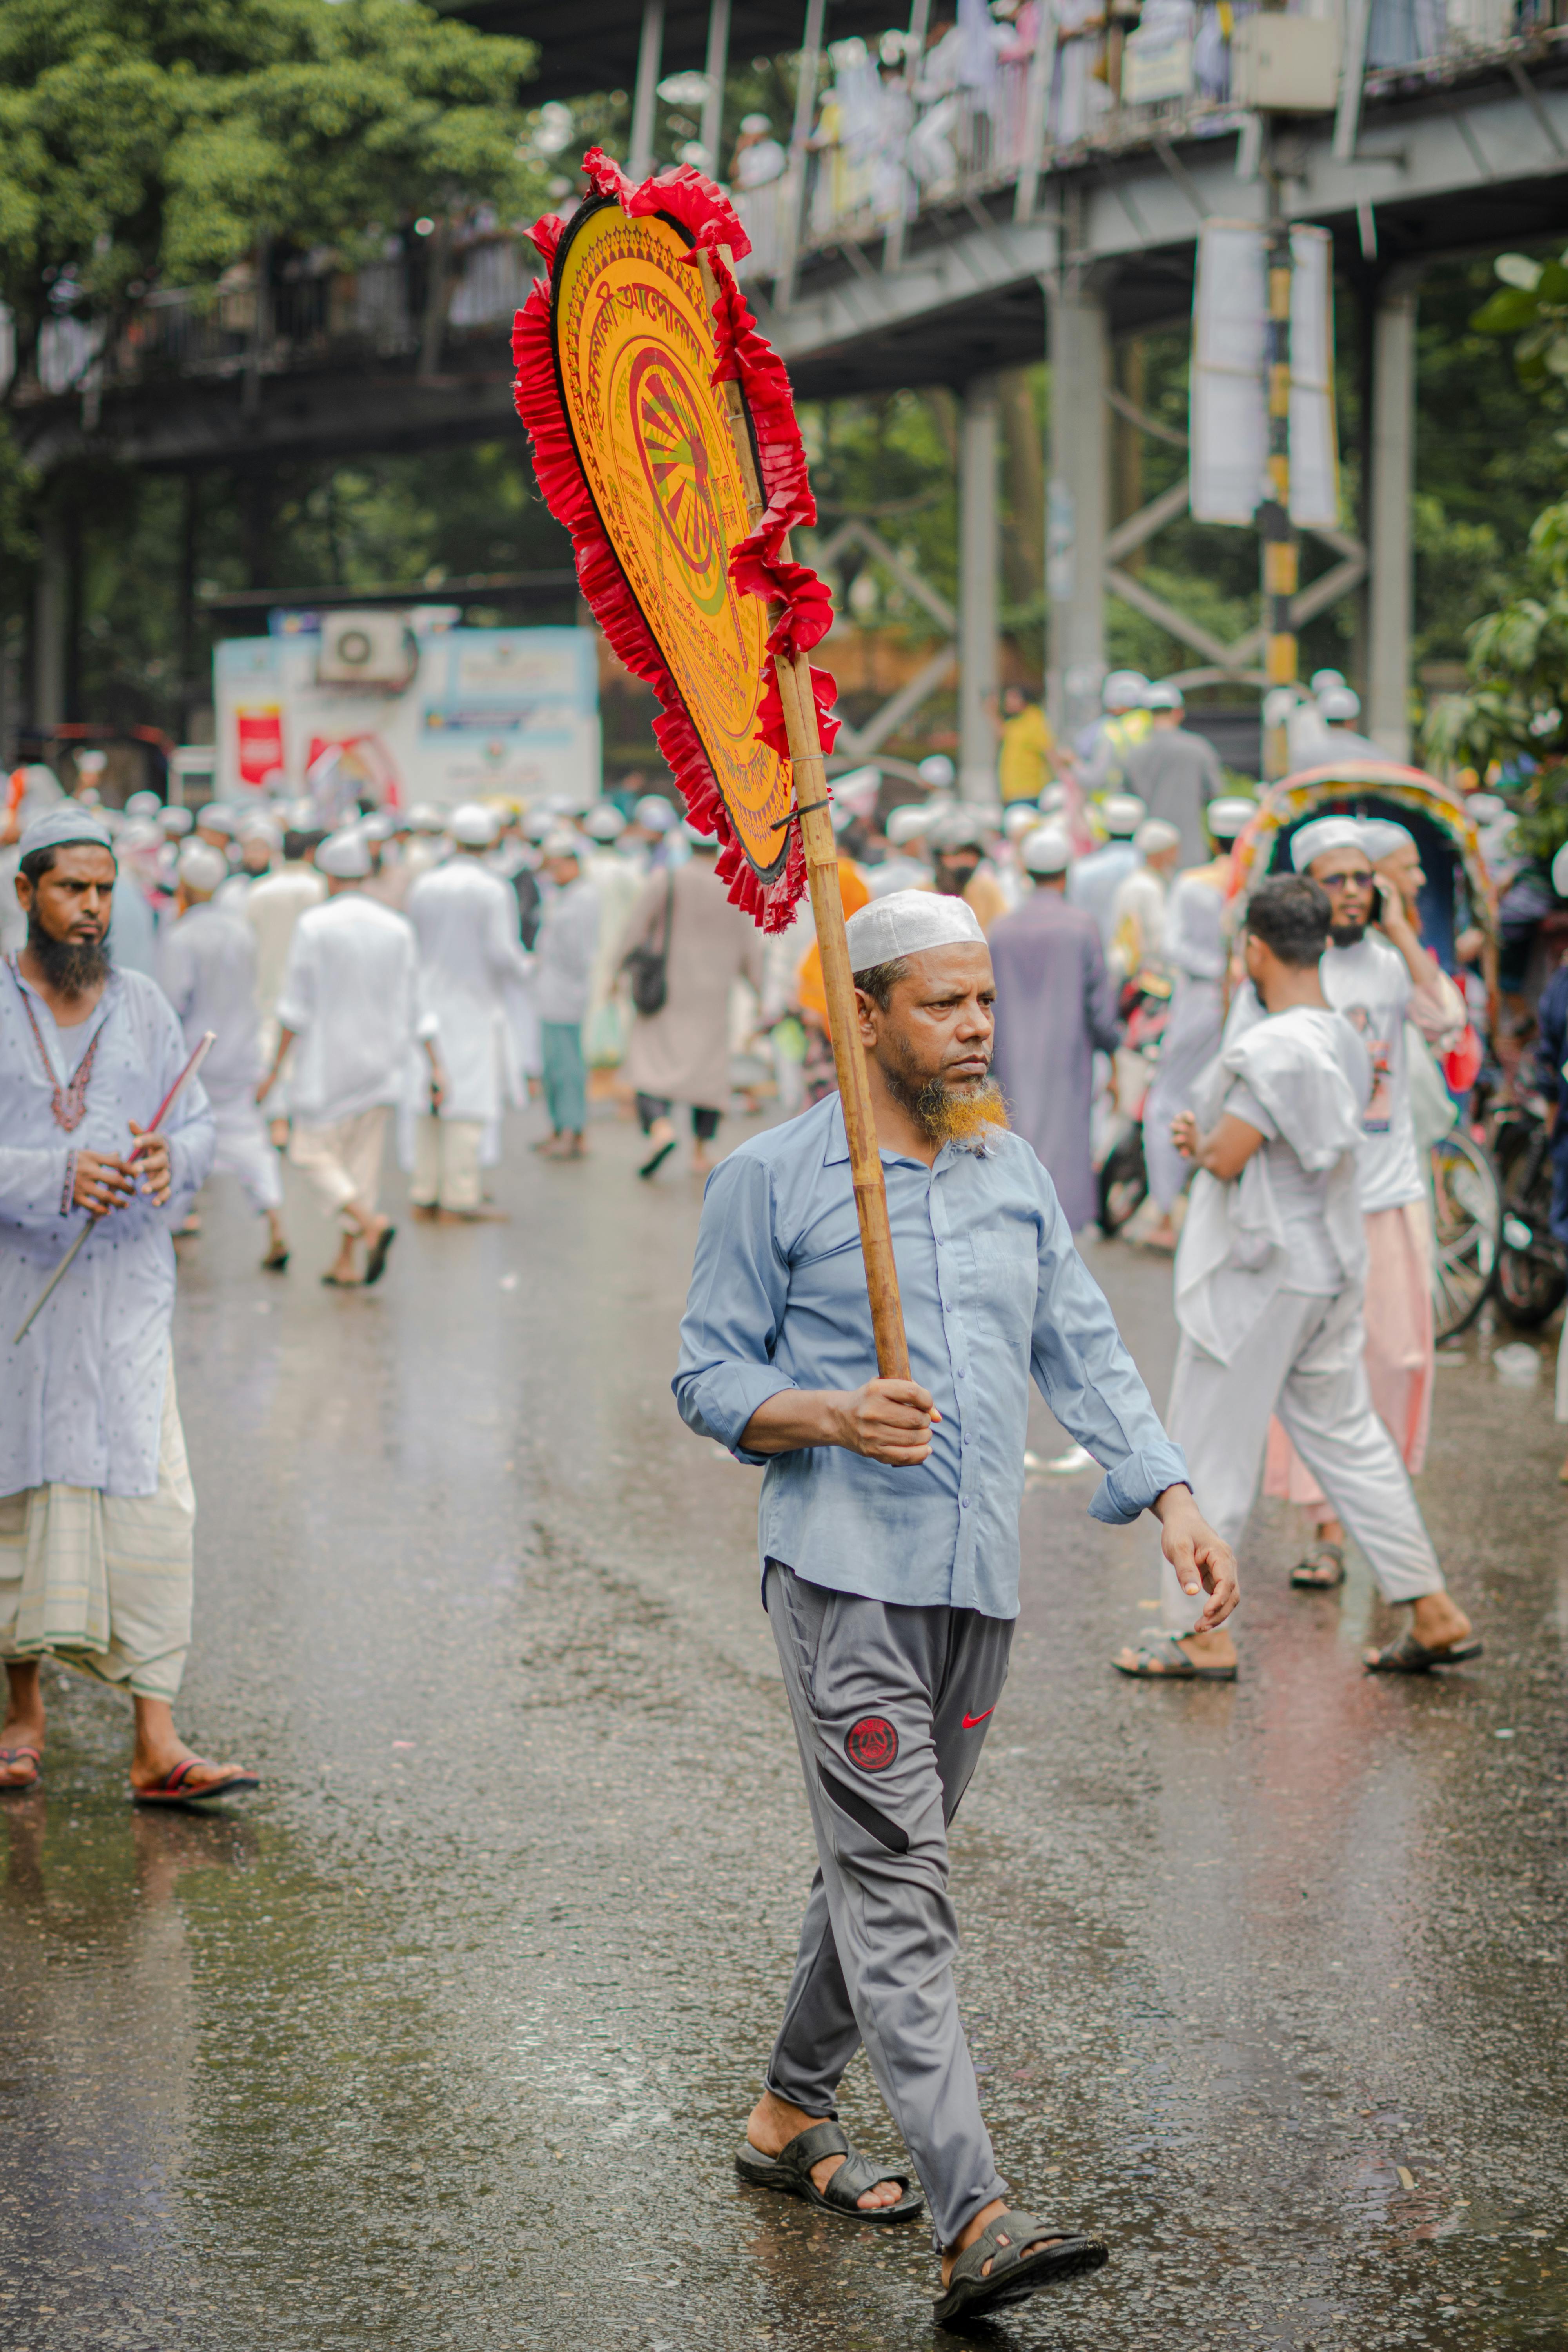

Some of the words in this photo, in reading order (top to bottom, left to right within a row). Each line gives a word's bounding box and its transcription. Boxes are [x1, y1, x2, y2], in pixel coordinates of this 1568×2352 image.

[586, 281, 619, 431] ইসলামী
[617, 283, 706, 368] আন্দোলন
[675, 588, 696, 624] মার্কা
[700, 619, 719, 653] দেখা
[707, 646, 746, 708] বাংলাদেশ
